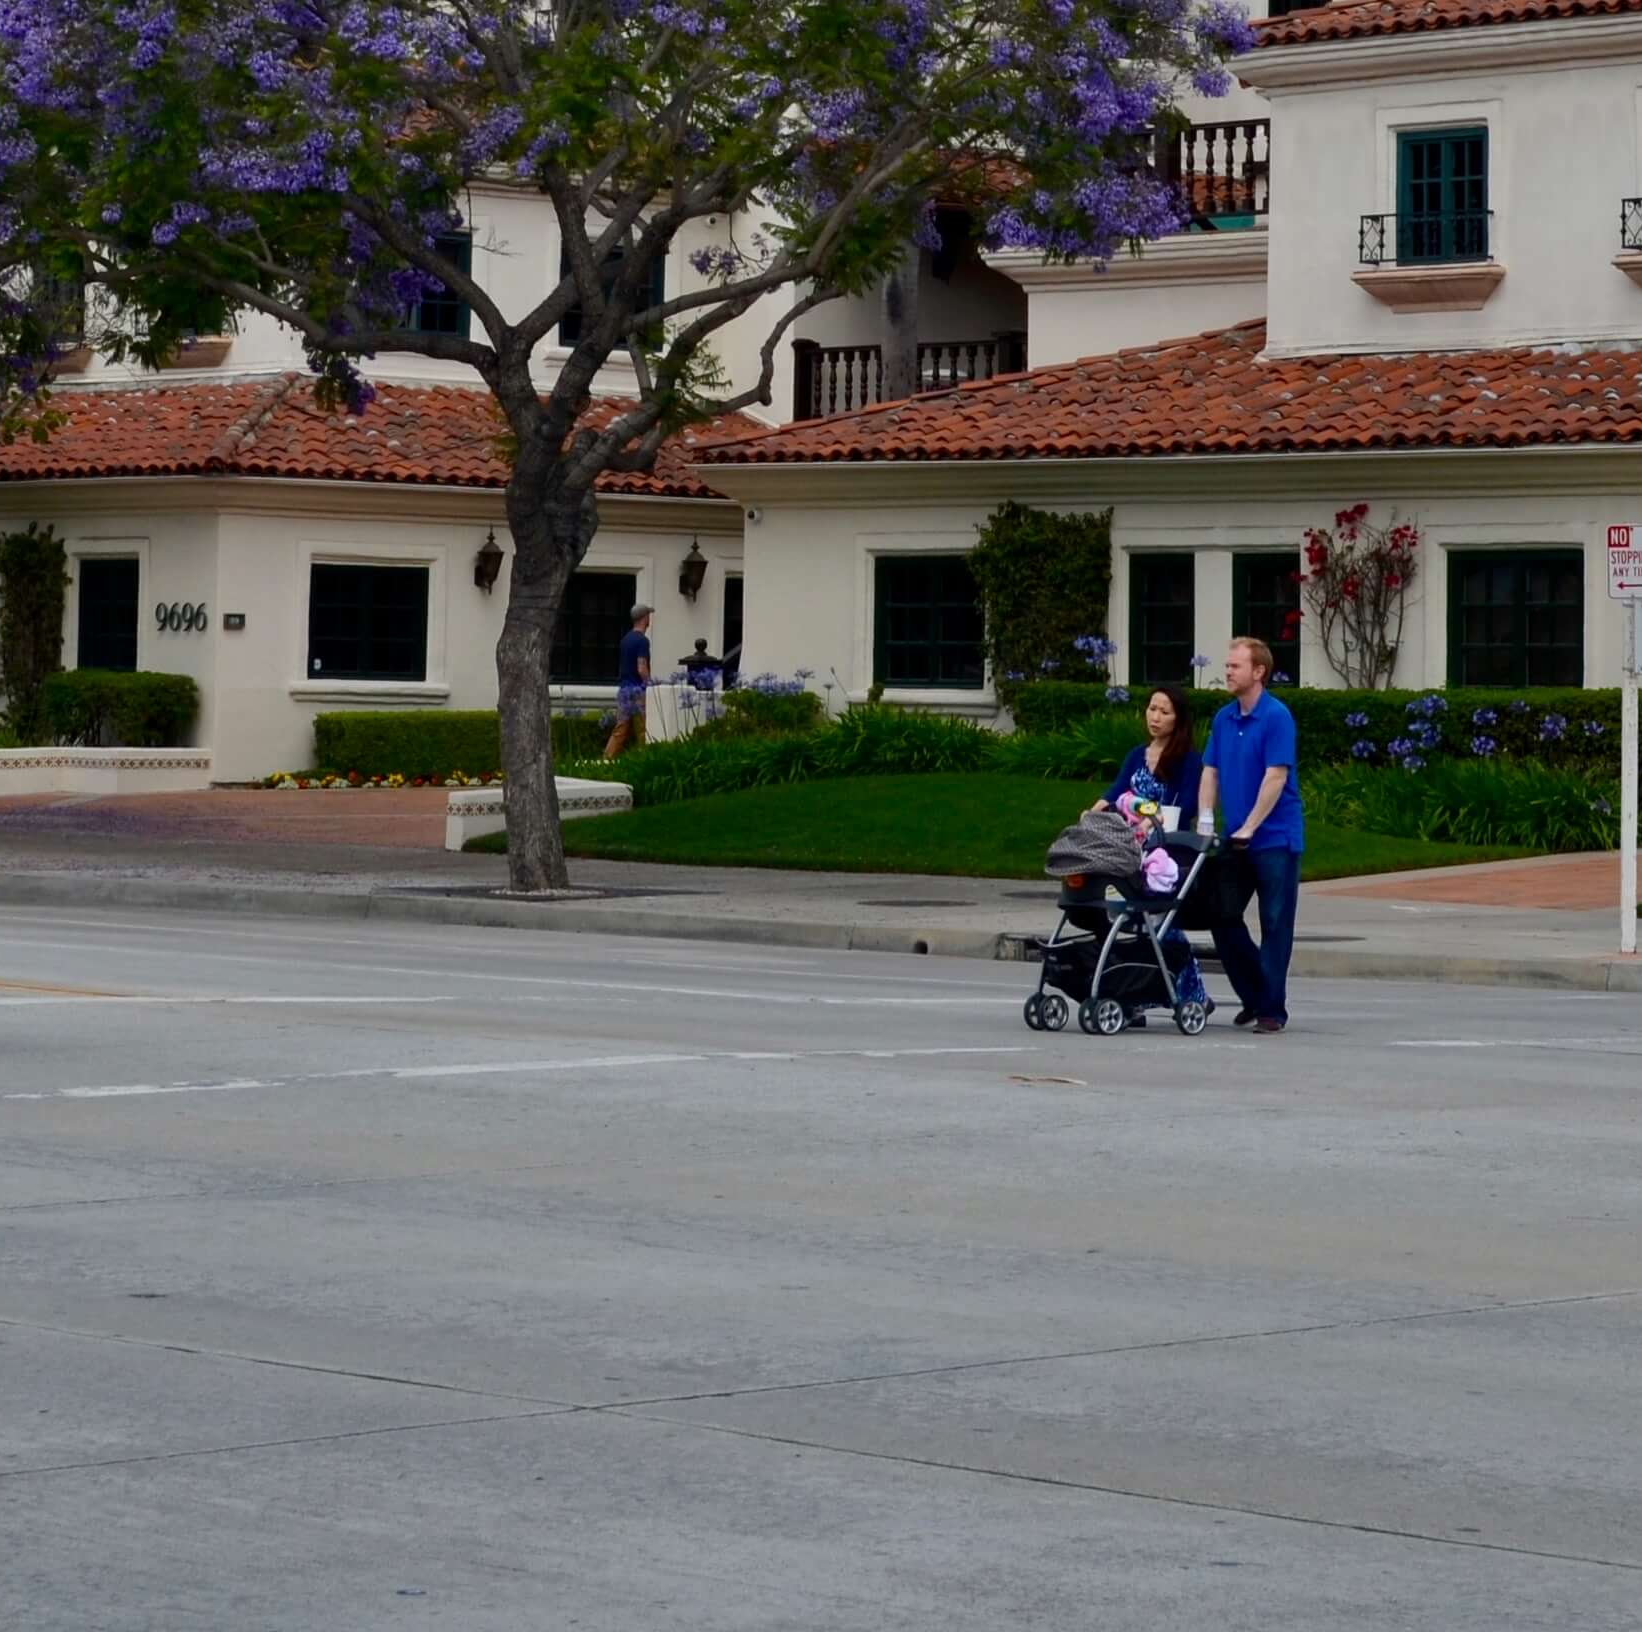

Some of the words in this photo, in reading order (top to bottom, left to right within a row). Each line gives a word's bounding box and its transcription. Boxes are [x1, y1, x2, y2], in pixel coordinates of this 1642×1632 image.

[1610, 527, 1628, 546] NO
[1612, 567, 1630, 577] ANY
[155, 602, 208, 632] 9696
